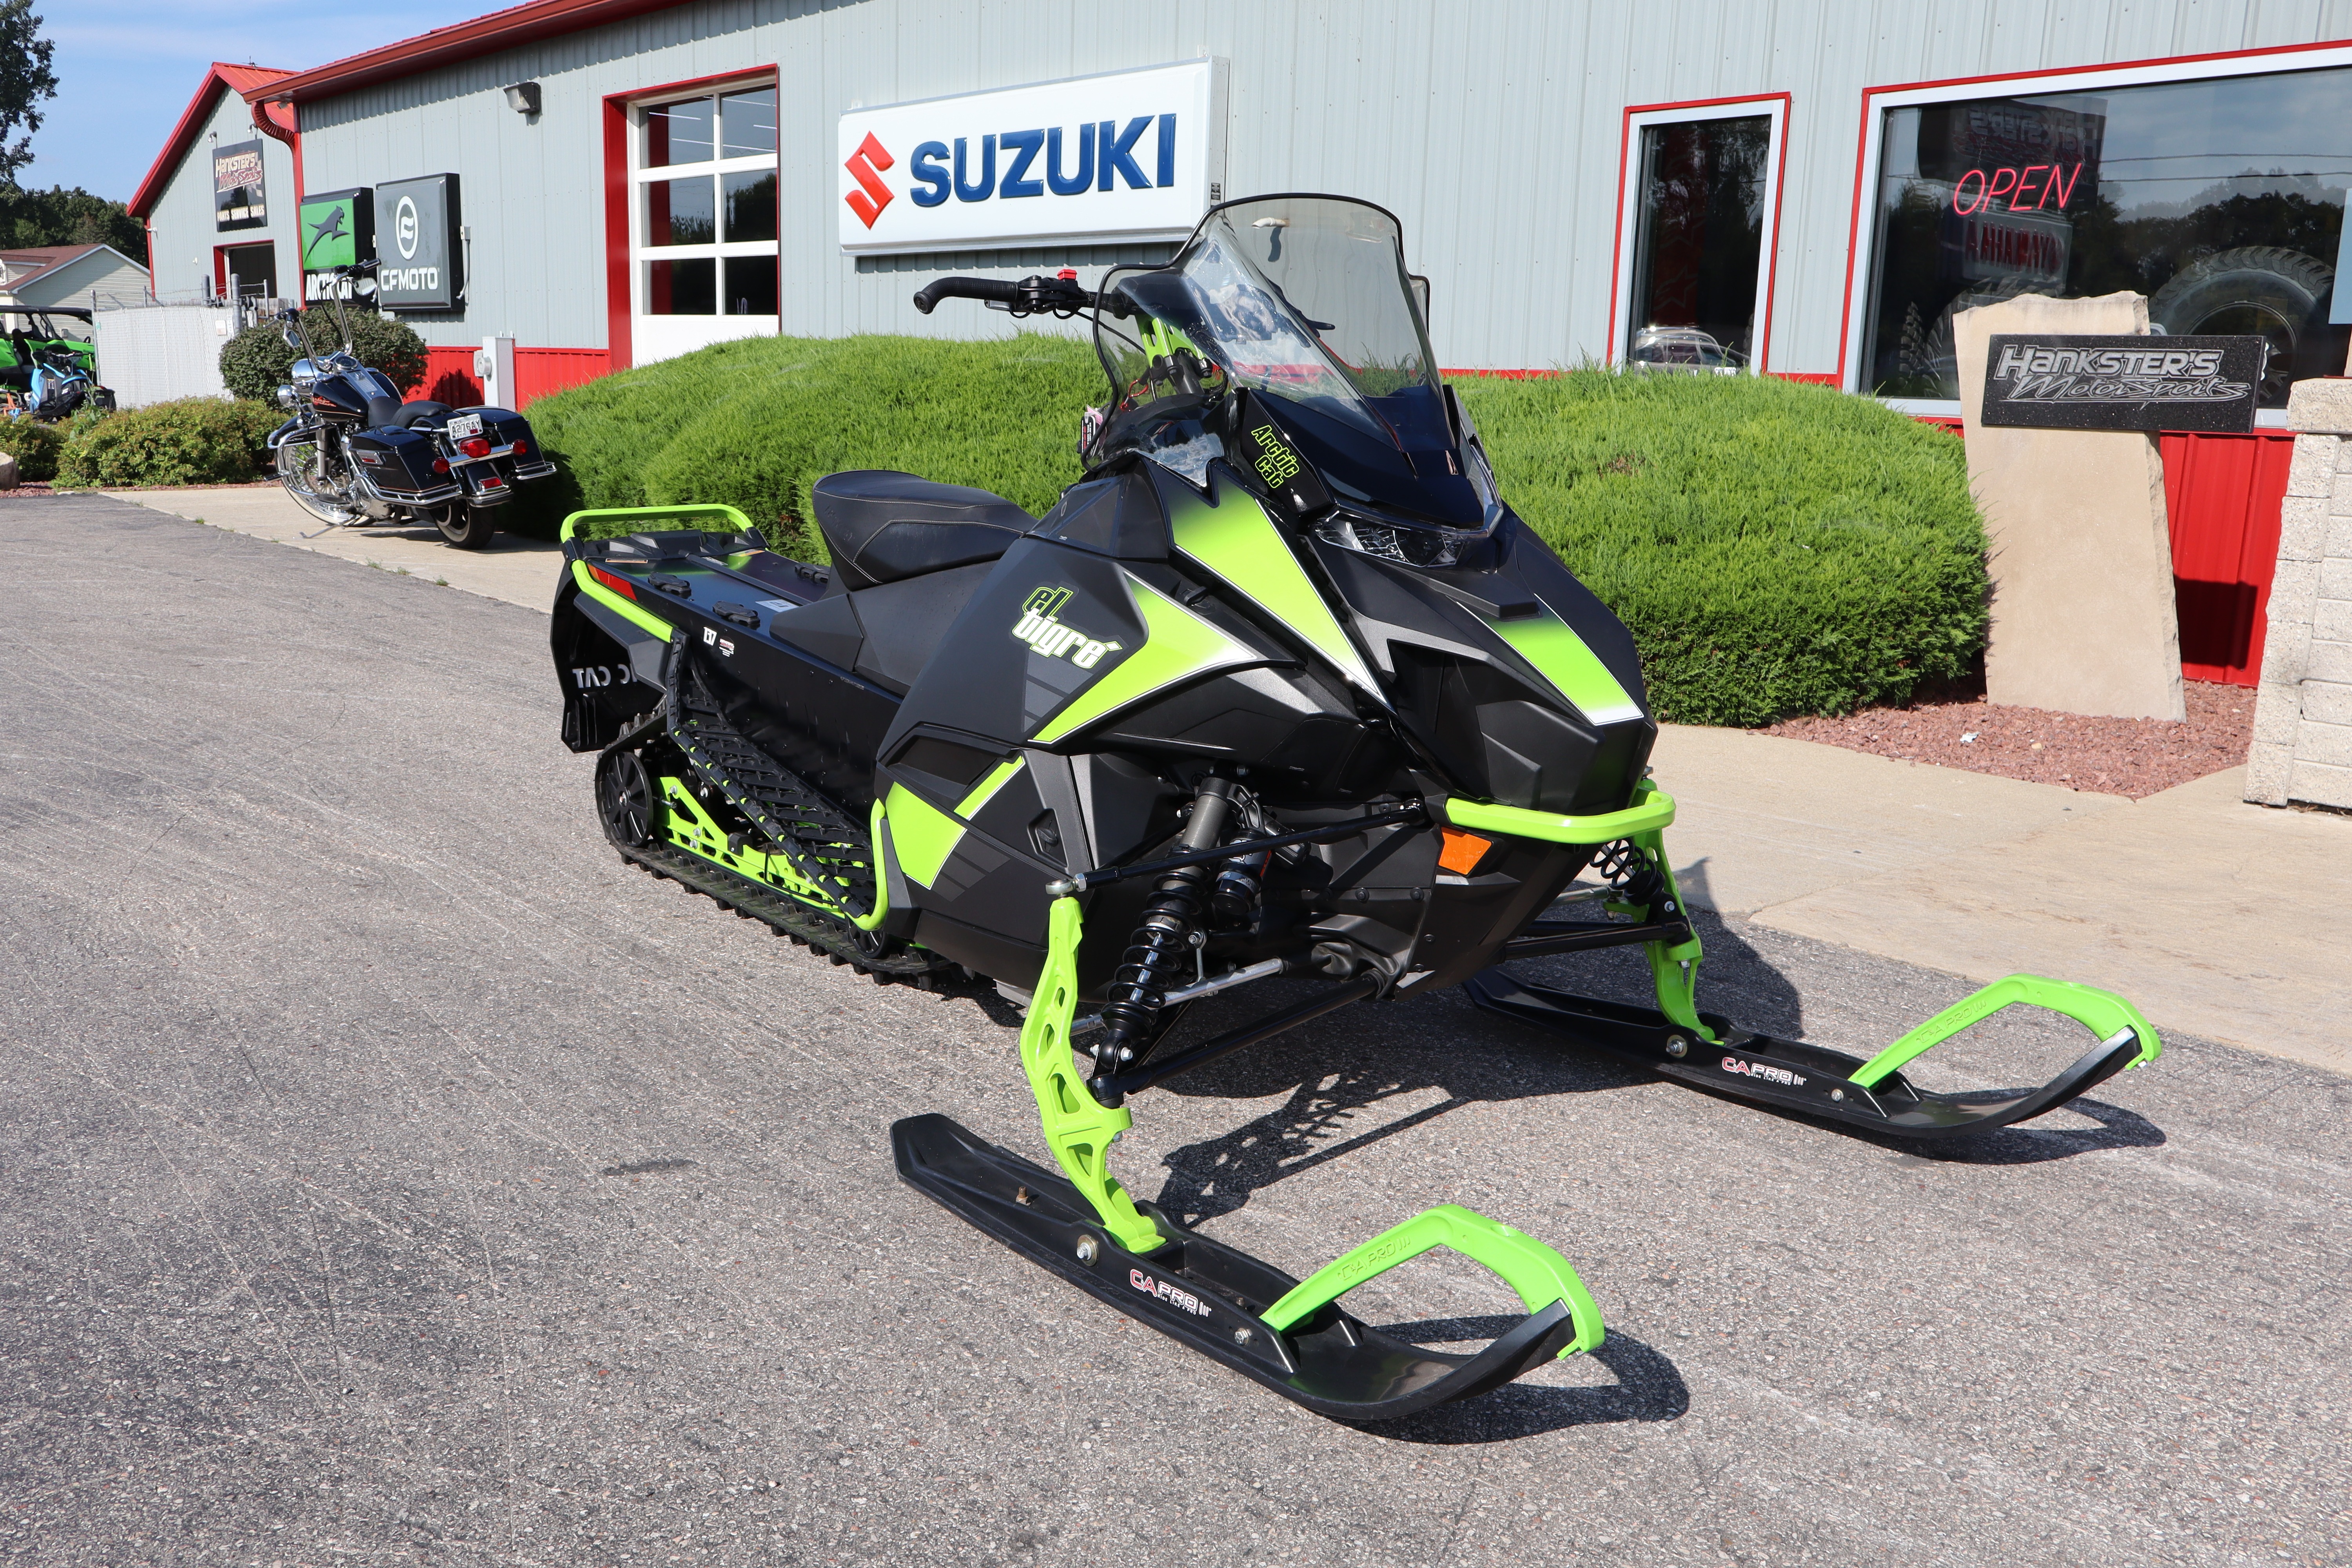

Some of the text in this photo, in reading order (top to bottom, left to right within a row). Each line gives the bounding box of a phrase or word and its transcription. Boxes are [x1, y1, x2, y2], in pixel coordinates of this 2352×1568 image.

[910, 113, 1176, 207] SUZUKI
[1953, 163, 2082, 216] OPEN
[217, 203, 265, 222] PARTS SERVICE SALES
[381, 267, 438, 291] CFMOTO
[452, 419, 480, 434] A276AY
[1251, 425, 1299, 477] Arctic
[1255, 455, 1284, 488] Cat
[1022, 586, 1074, 619] el
[703, 627, 717, 646] 137
[1945, 1007, 1973, 1029] PRO
[1751, 1063, 1793, 1083] PRO
[1367, 1241, 1396, 1267] PRO
[1157, 1294, 1168, 1302] RIDE
[1158, 1281, 1198, 1312] PRO
